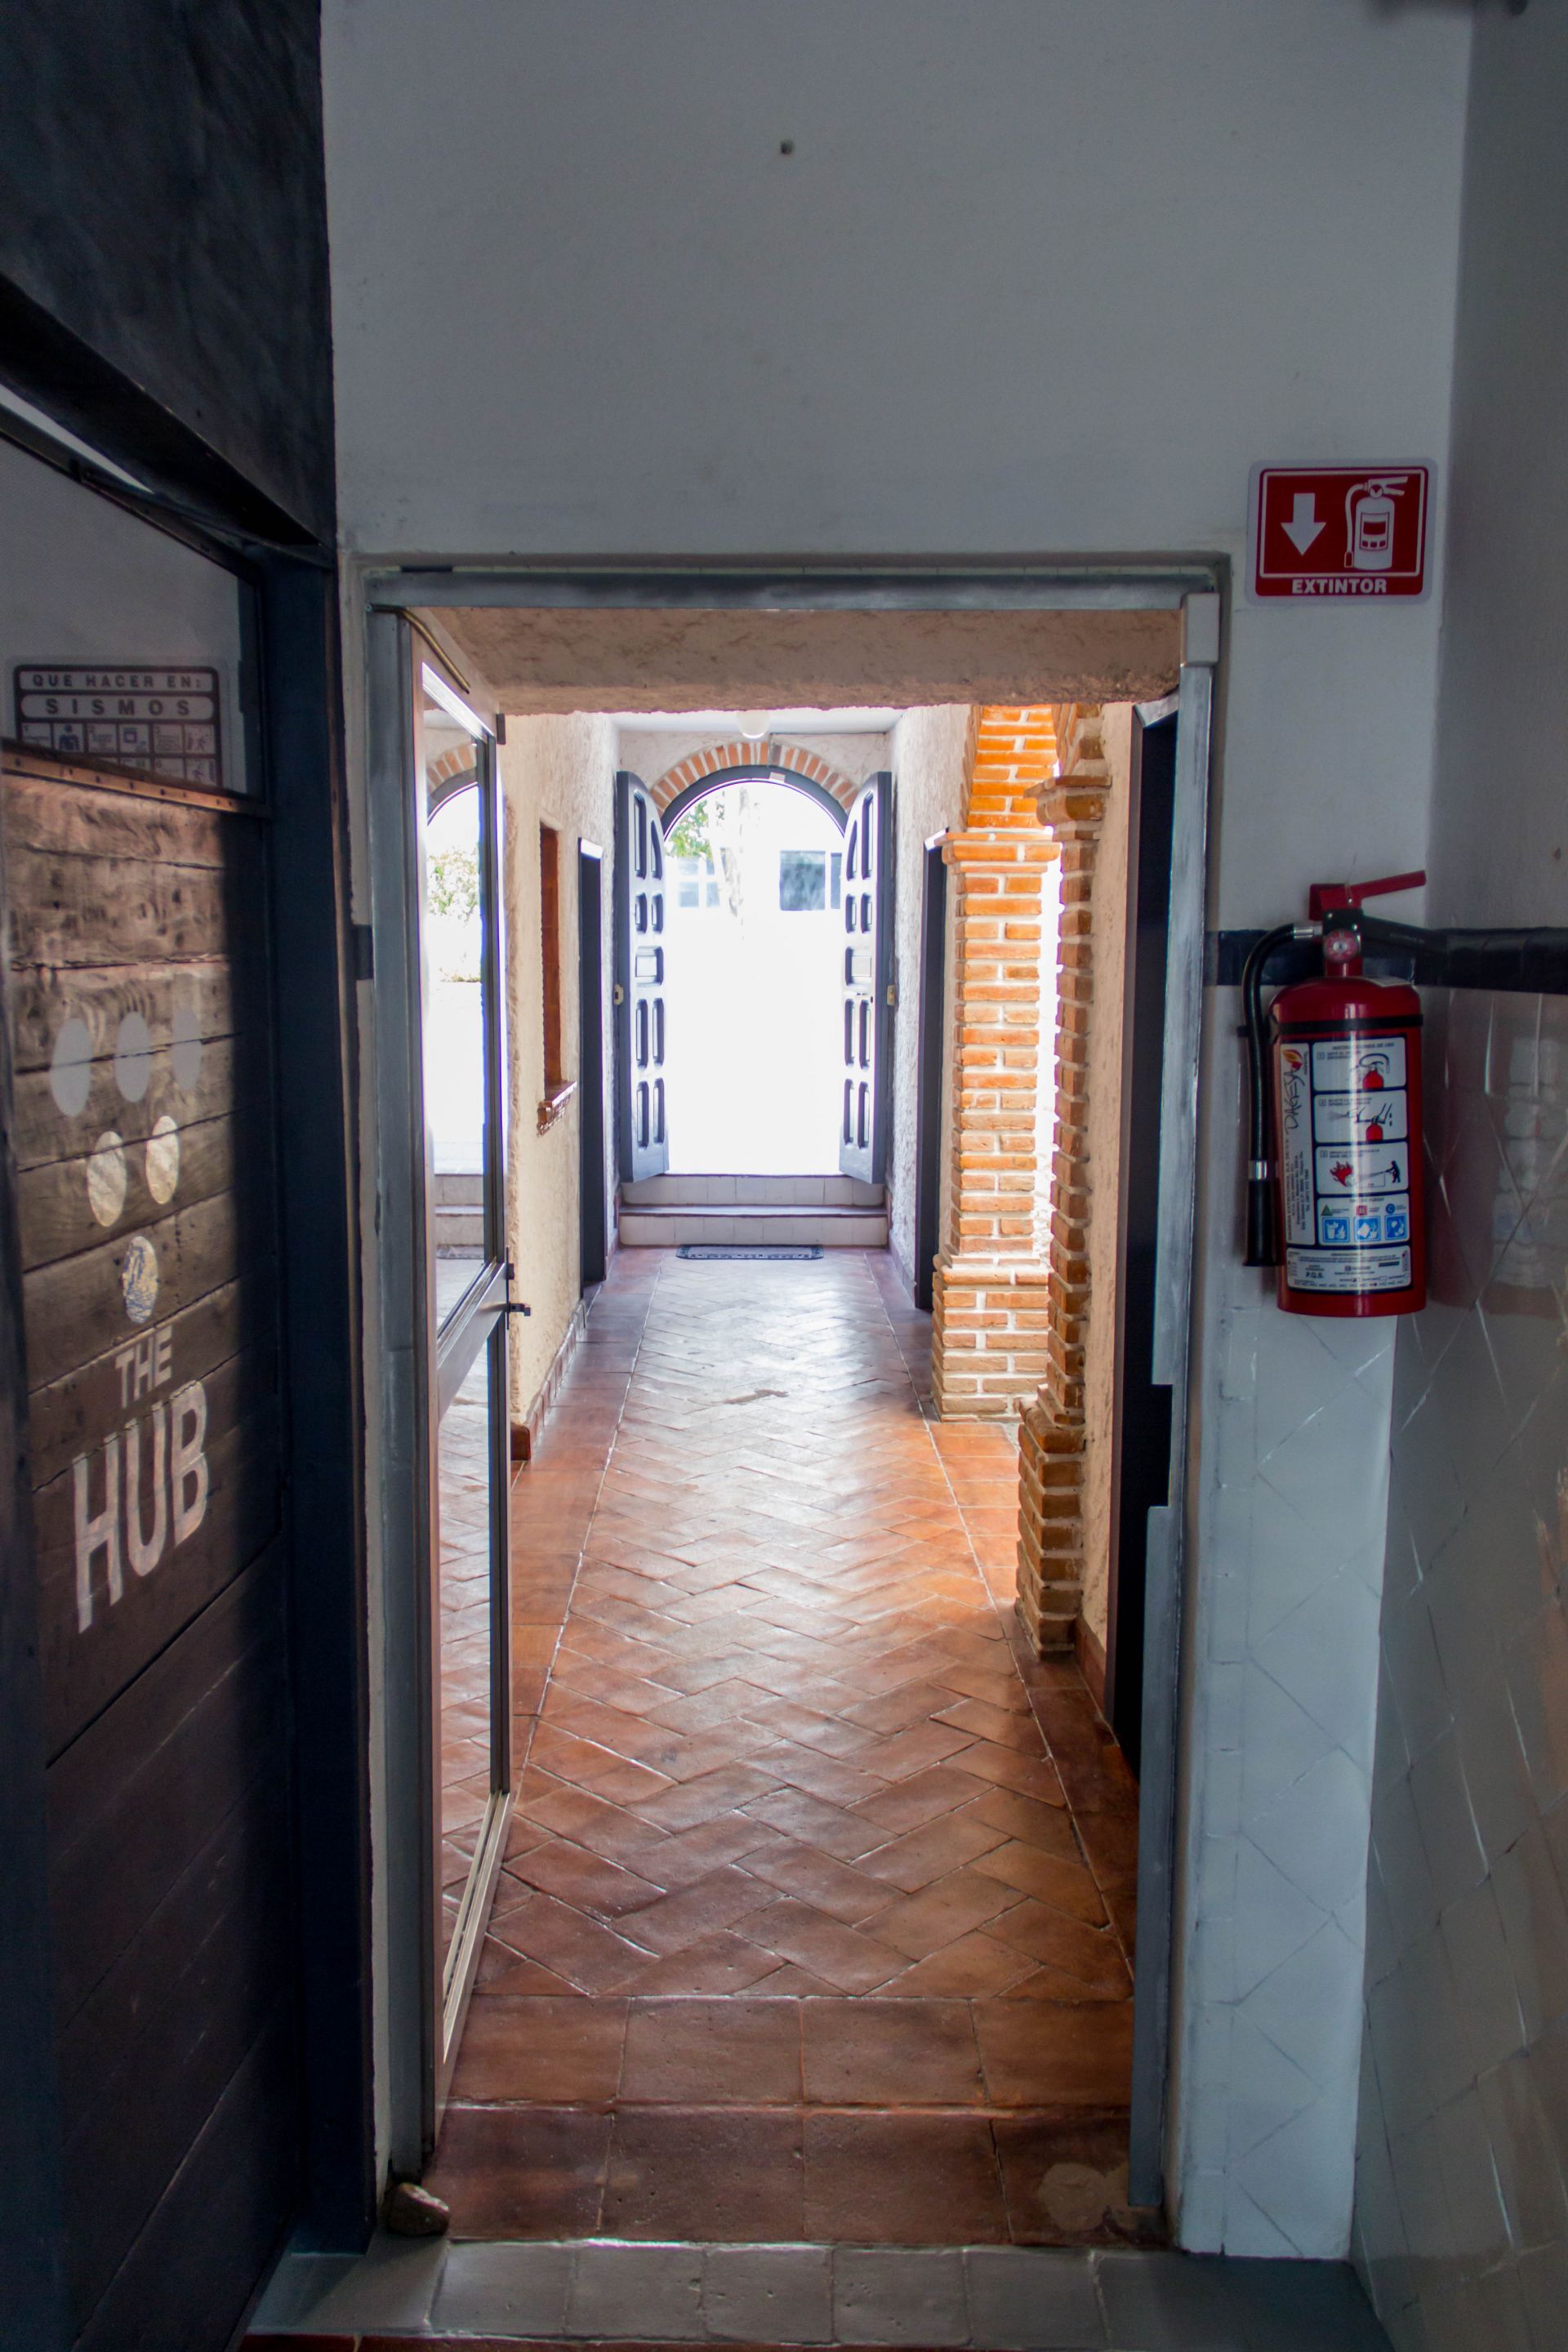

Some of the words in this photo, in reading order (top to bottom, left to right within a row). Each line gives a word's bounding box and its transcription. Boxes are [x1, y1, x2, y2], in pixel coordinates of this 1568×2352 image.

[1291, 578, 1388, 595] EXTINTOR
[33, 674, 73, 688] QUE
[86, 674, 154, 688] HACER
[167, 675, 203, 689] EN:
[46, 698, 190, 716] SISMOS
[115, 1325, 172, 1409] THE
[72, 1379, 209, 1634] HUB
